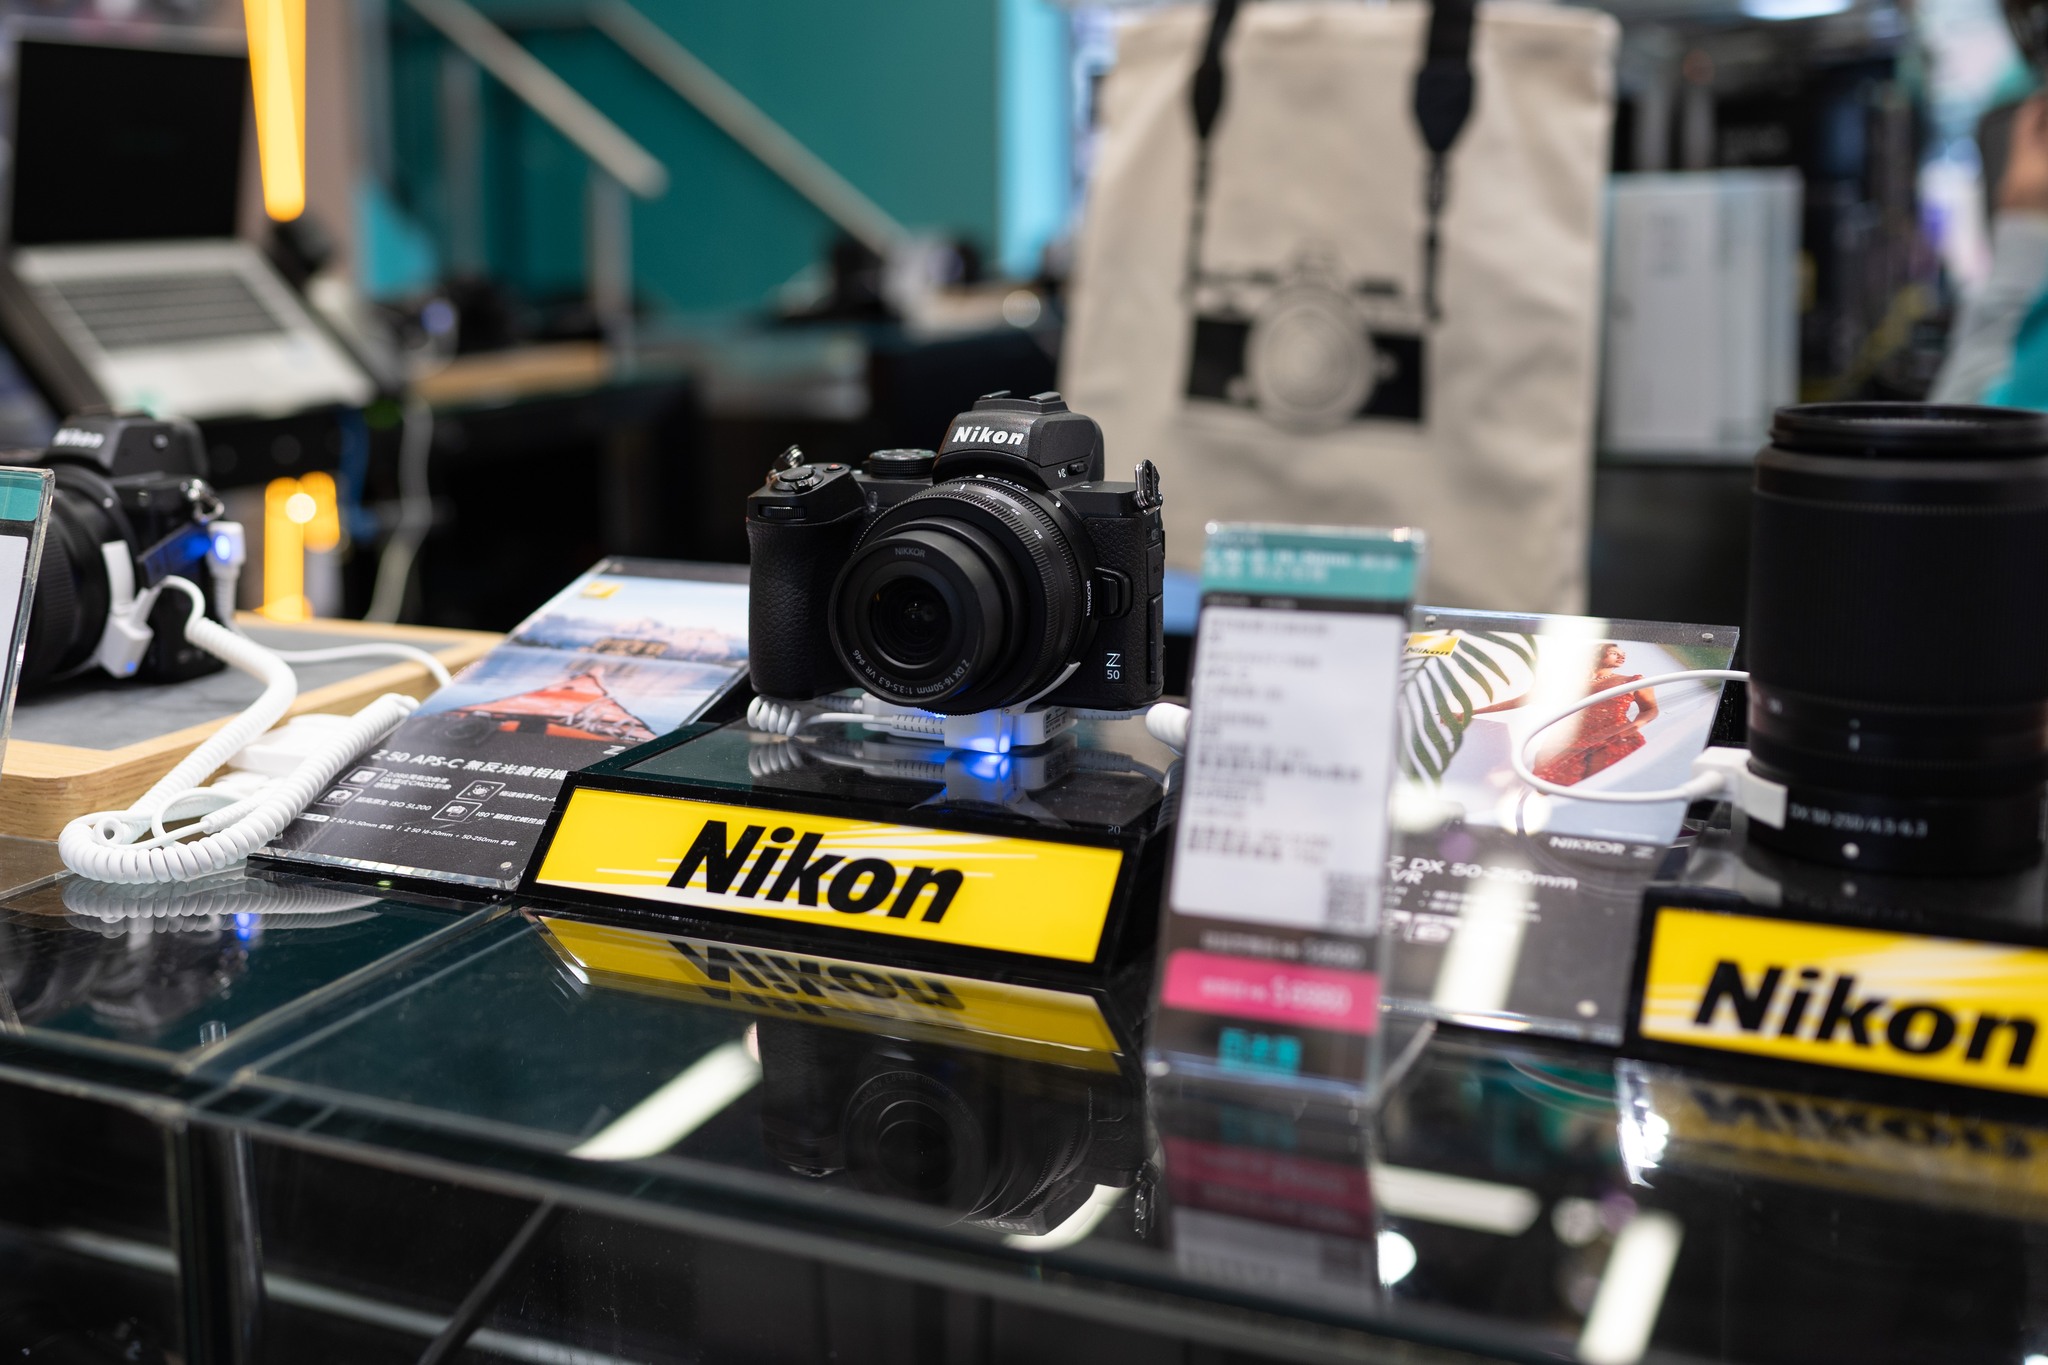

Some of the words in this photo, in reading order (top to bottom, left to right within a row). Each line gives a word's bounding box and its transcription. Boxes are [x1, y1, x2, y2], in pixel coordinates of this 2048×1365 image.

[52, 427, 105, 449] Nikon
[952, 426, 1024, 446] Nikon
[1033, 529, 1043, 540] 50
[894, 546, 926, 558] NIKKOR
[1105, 652, 1121, 667] Z
[865, 666, 877, 679] VR
[952, 666, 965, 680] DX
[1106, 669, 1120, 680] 50
[916, 676, 954, 695] 16-50mm
[386, 751, 411, 763] 50
[408, 754, 465, 769] APS-C
[422, 830, 453, 838] 16-50mm
[461, 834, 499, 844] 50-250mm
[1550, 836, 1626, 857] NIKKOR
[1632, 844, 1655, 859] Z
[666, 820, 964, 923] Nikon
[1408, 857, 1446, 874] DX
[1391, 869, 1424, 885] VR
[1694, 958, 2038, 1069] Nikon
